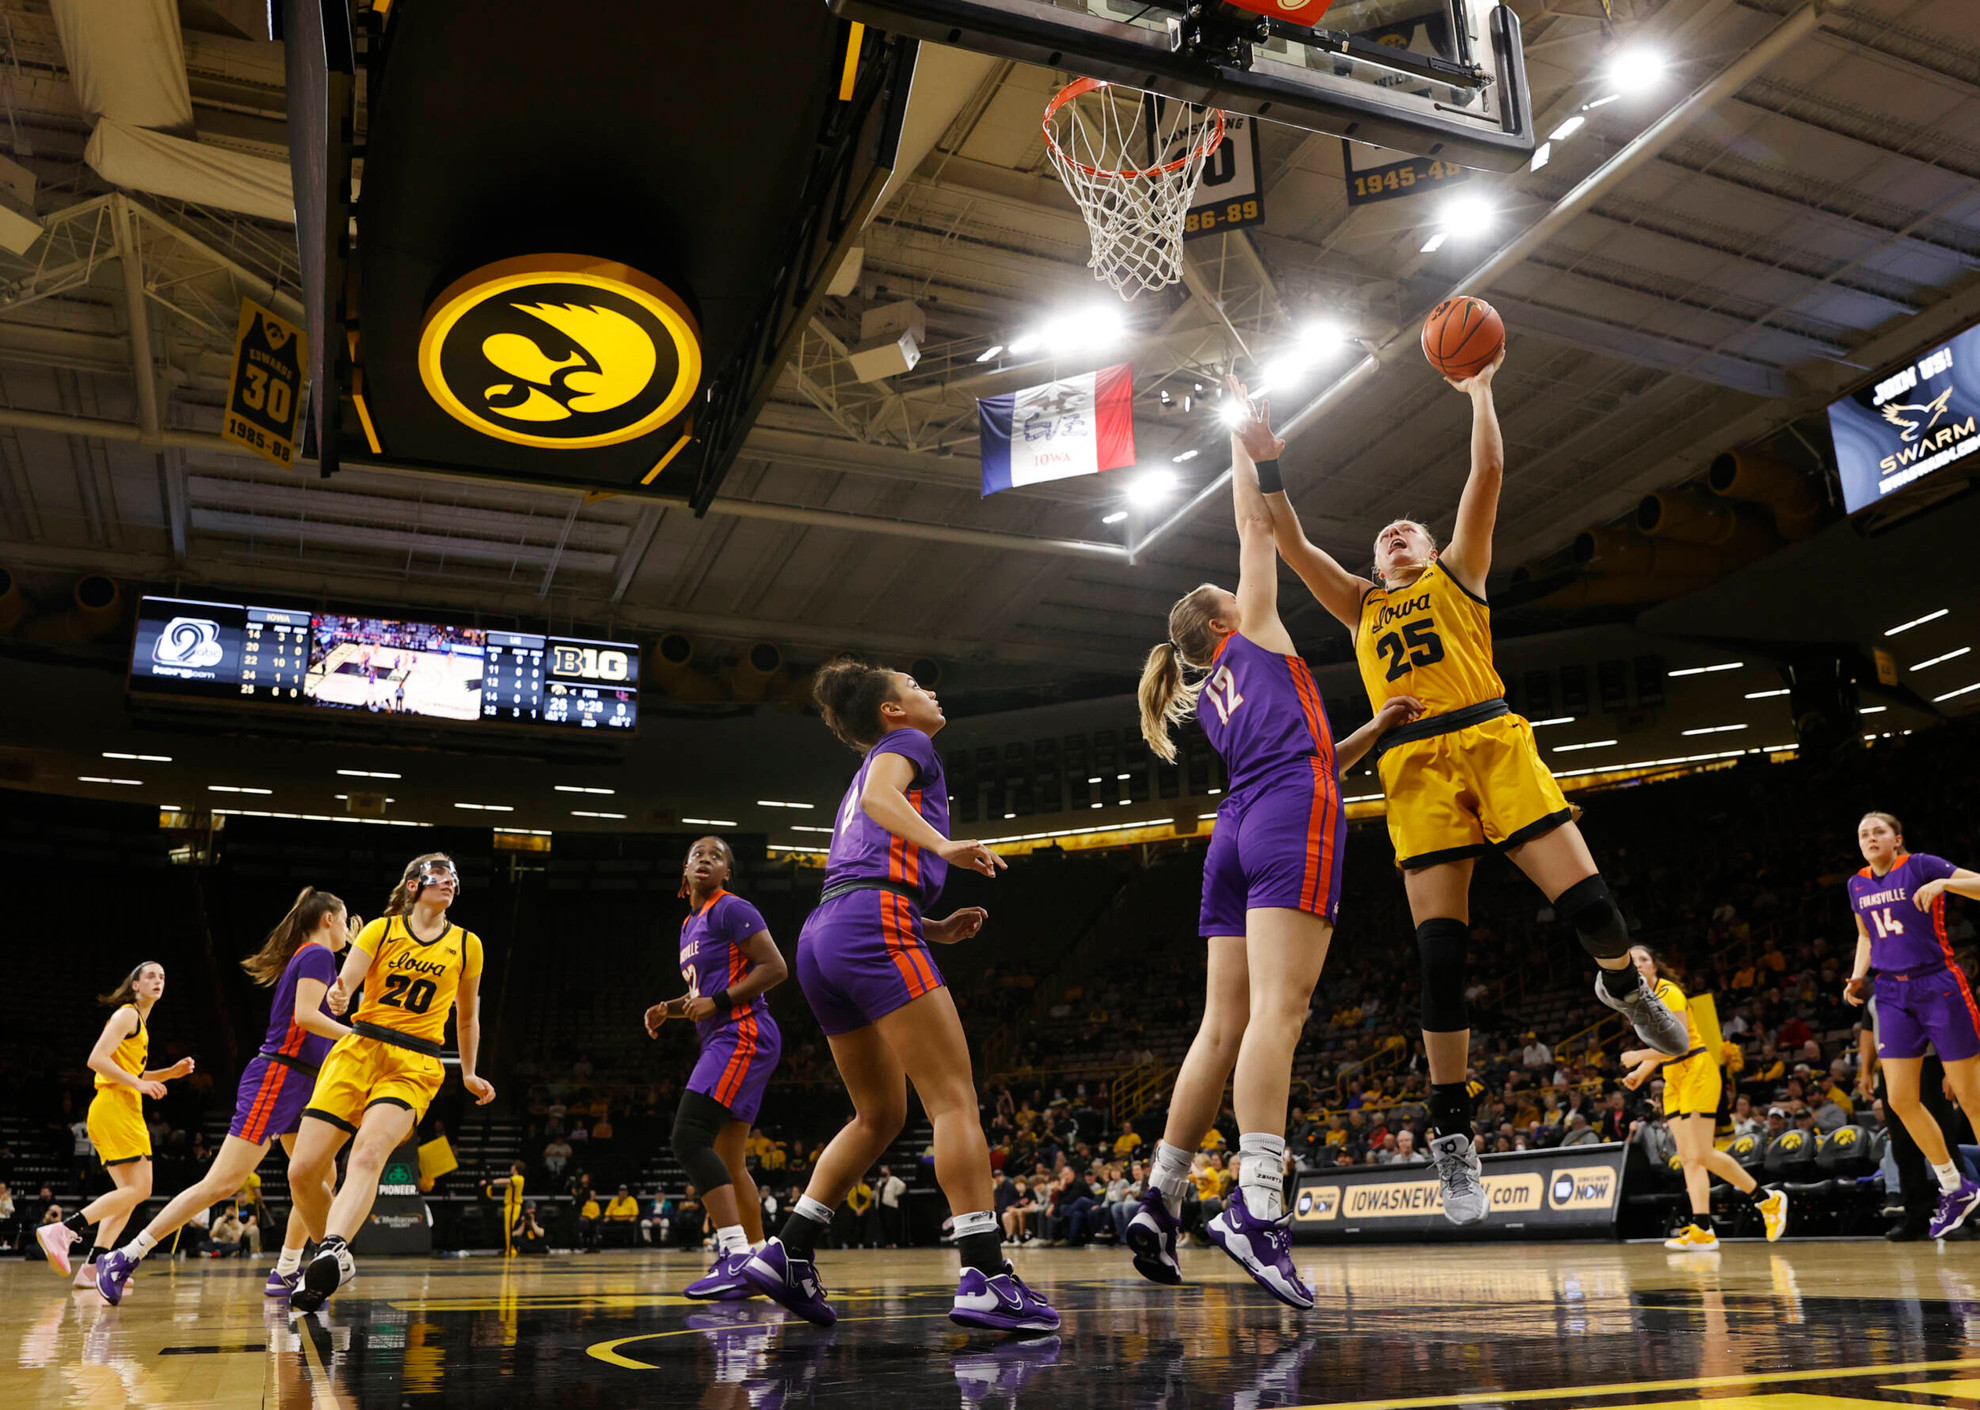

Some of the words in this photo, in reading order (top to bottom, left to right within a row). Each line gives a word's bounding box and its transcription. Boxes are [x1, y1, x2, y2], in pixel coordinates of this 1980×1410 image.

[1185, 200, 1258, 233] 86-89
[250, 349, 293, 381] EDWARDS
[1874, 367, 1917, 405] JOIN
[1918, 347, 1953, 380] US!
[242, 363, 292, 424] 30
[229, 418, 291, 462] 1985-88
[1880, 417, 1975, 475] SWARM
[1034, 452, 1071, 467] IOWA
[266, 613, 291, 623] IOWA
[1373, 593, 1431, 634] Iowa
[248, 630, 261, 639] 14
[278, 632, 285, 641] 3
[295, 634, 303, 643] 0
[246, 641, 259, 652] 20
[278, 645, 284, 654] 1
[294, 646, 302, 656] 0
[1376, 618, 1445, 683] 25
[244, 655, 258, 665] 22
[273, 657, 286, 668] 10
[294, 660, 300, 669] 1
[490, 652, 498, 662] 0
[516, 655, 523, 665] 0
[532, 656, 540, 666] 0
[242, 669, 256, 680] 24
[275, 672, 281, 682] 1
[293, 674, 299, 684] 1
[488, 664, 499, 675] 11
[515, 667, 523, 677] 0
[532, 668, 539, 678] 0
[241, 684, 255, 694] 25
[272, 686, 279, 696] 6
[290, 688, 298, 698] 0
[487, 677, 499, 687] 12
[514, 680, 522, 689] 4
[531, 681, 538, 691] 0
[485, 691, 498, 702] 14
[513, 693, 521, 704] 0
[531, 695, 537, 705] 1
[1205, 665, 1245, 726] 12
[484, 705, 497, 716] 32
[512, 707, 520, 717] 3
[530, 709, 537, 719] 1
[616, 703, 626, 716] 9
[1859, 887, 1907, 909] EVANSVILLE
[1870, 907, 1904, 939] 14
[388, 951, 446, 977] Iowa
[378, 973, 437, 1014] 20
[1575, 1183, 1609, 1201] NOW
